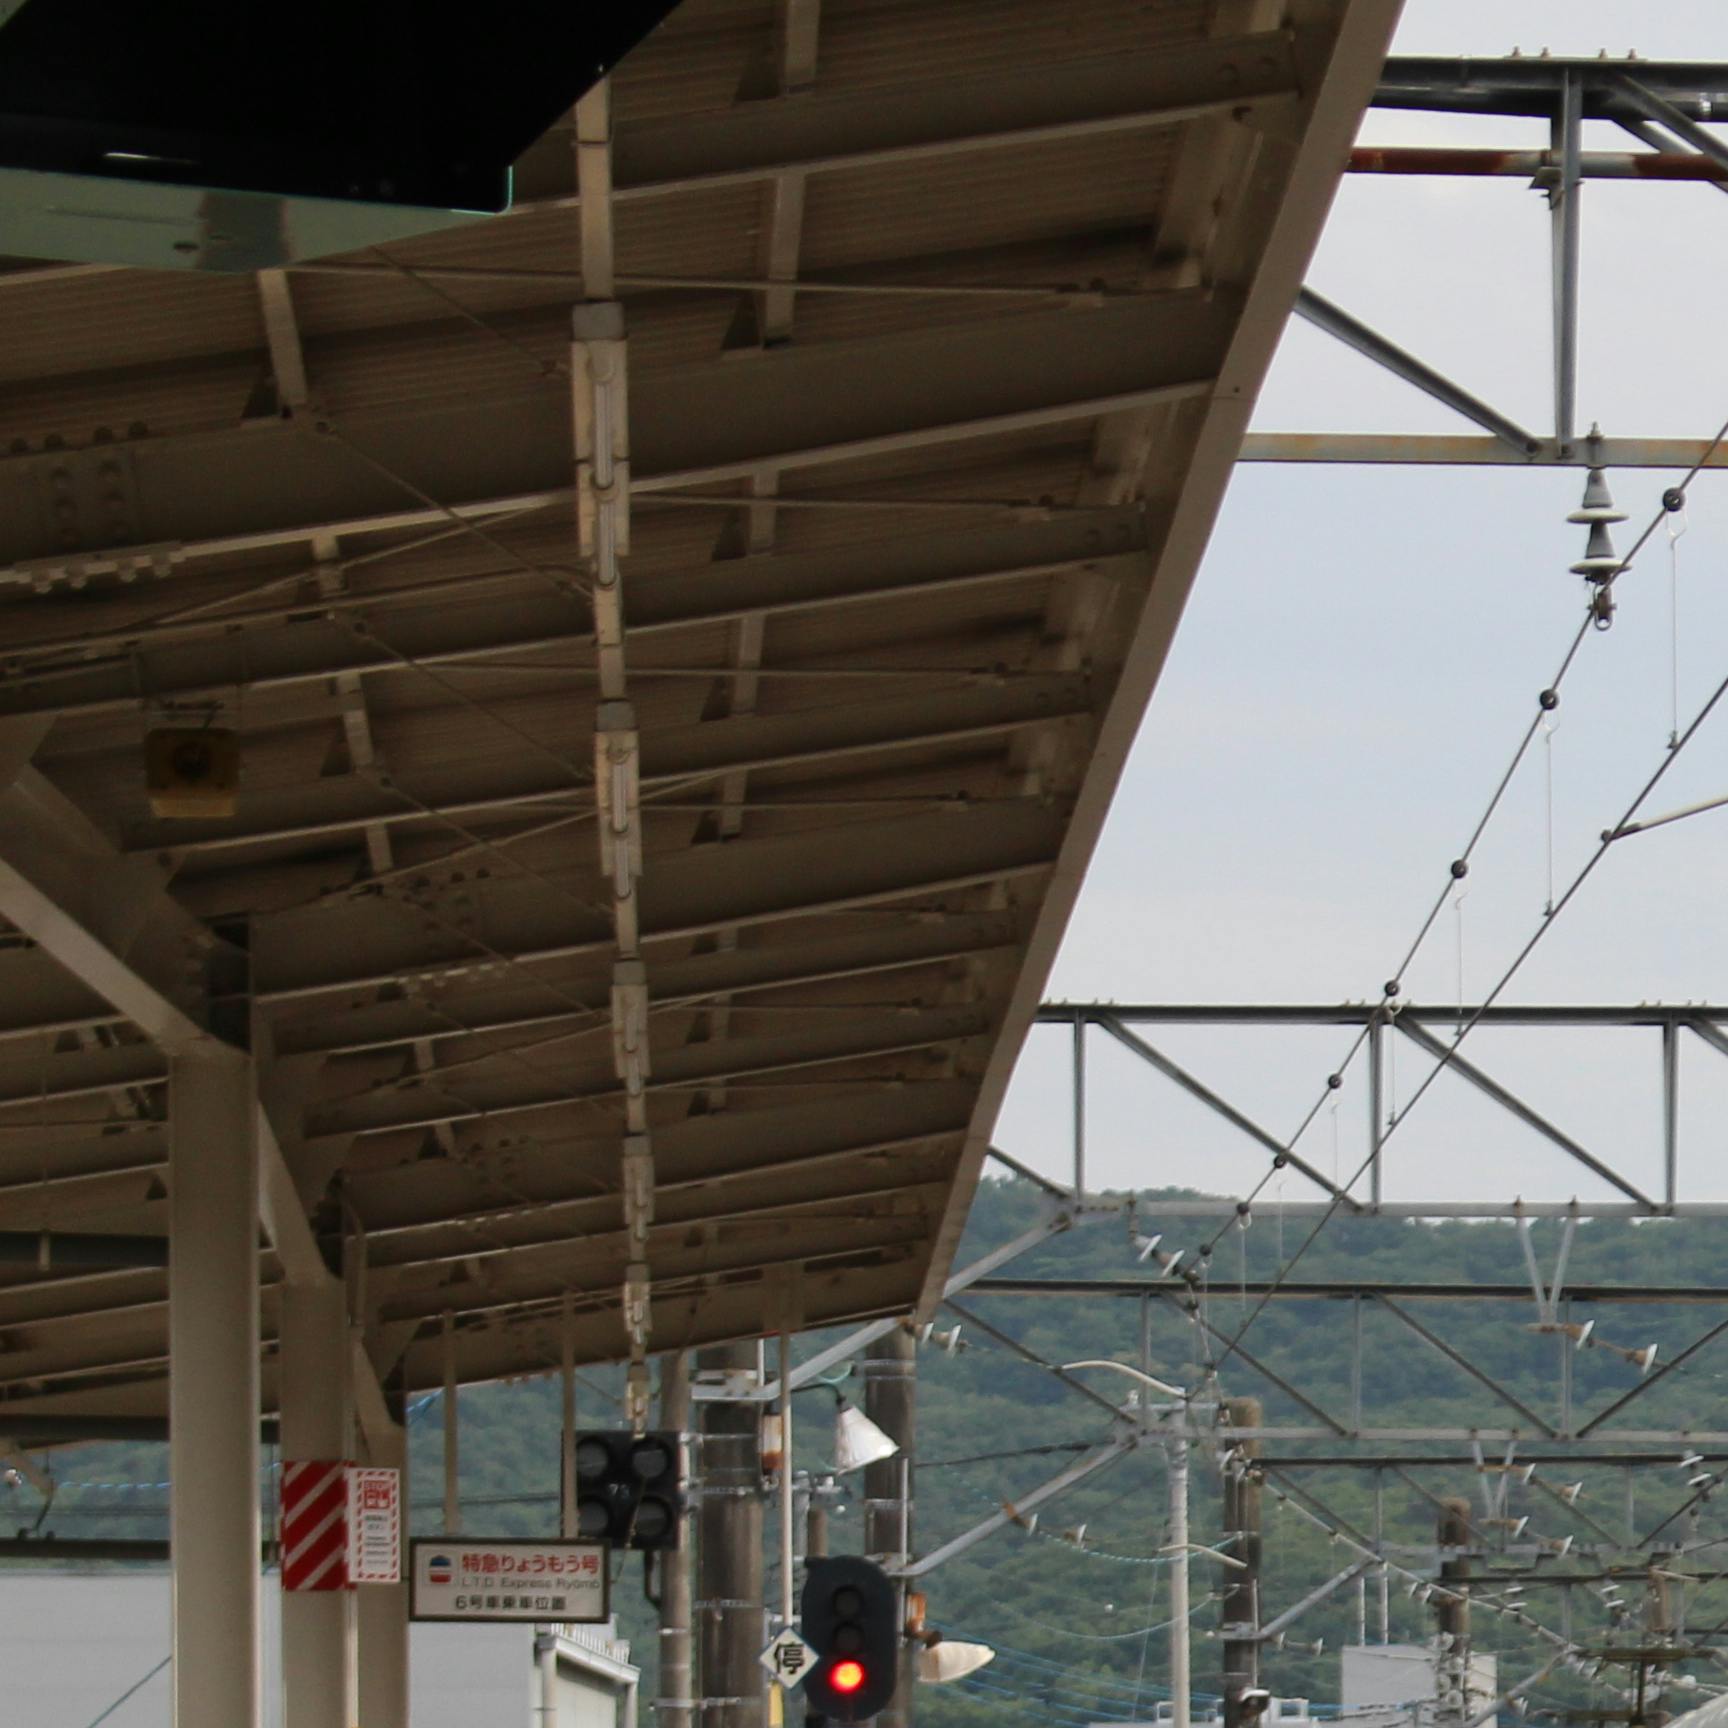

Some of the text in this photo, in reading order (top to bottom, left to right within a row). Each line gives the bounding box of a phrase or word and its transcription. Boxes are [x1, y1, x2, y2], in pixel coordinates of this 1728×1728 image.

[462, 1554, 600, 1574] 特急りょうもう号
[774, 1642, 804, 1675] 停
